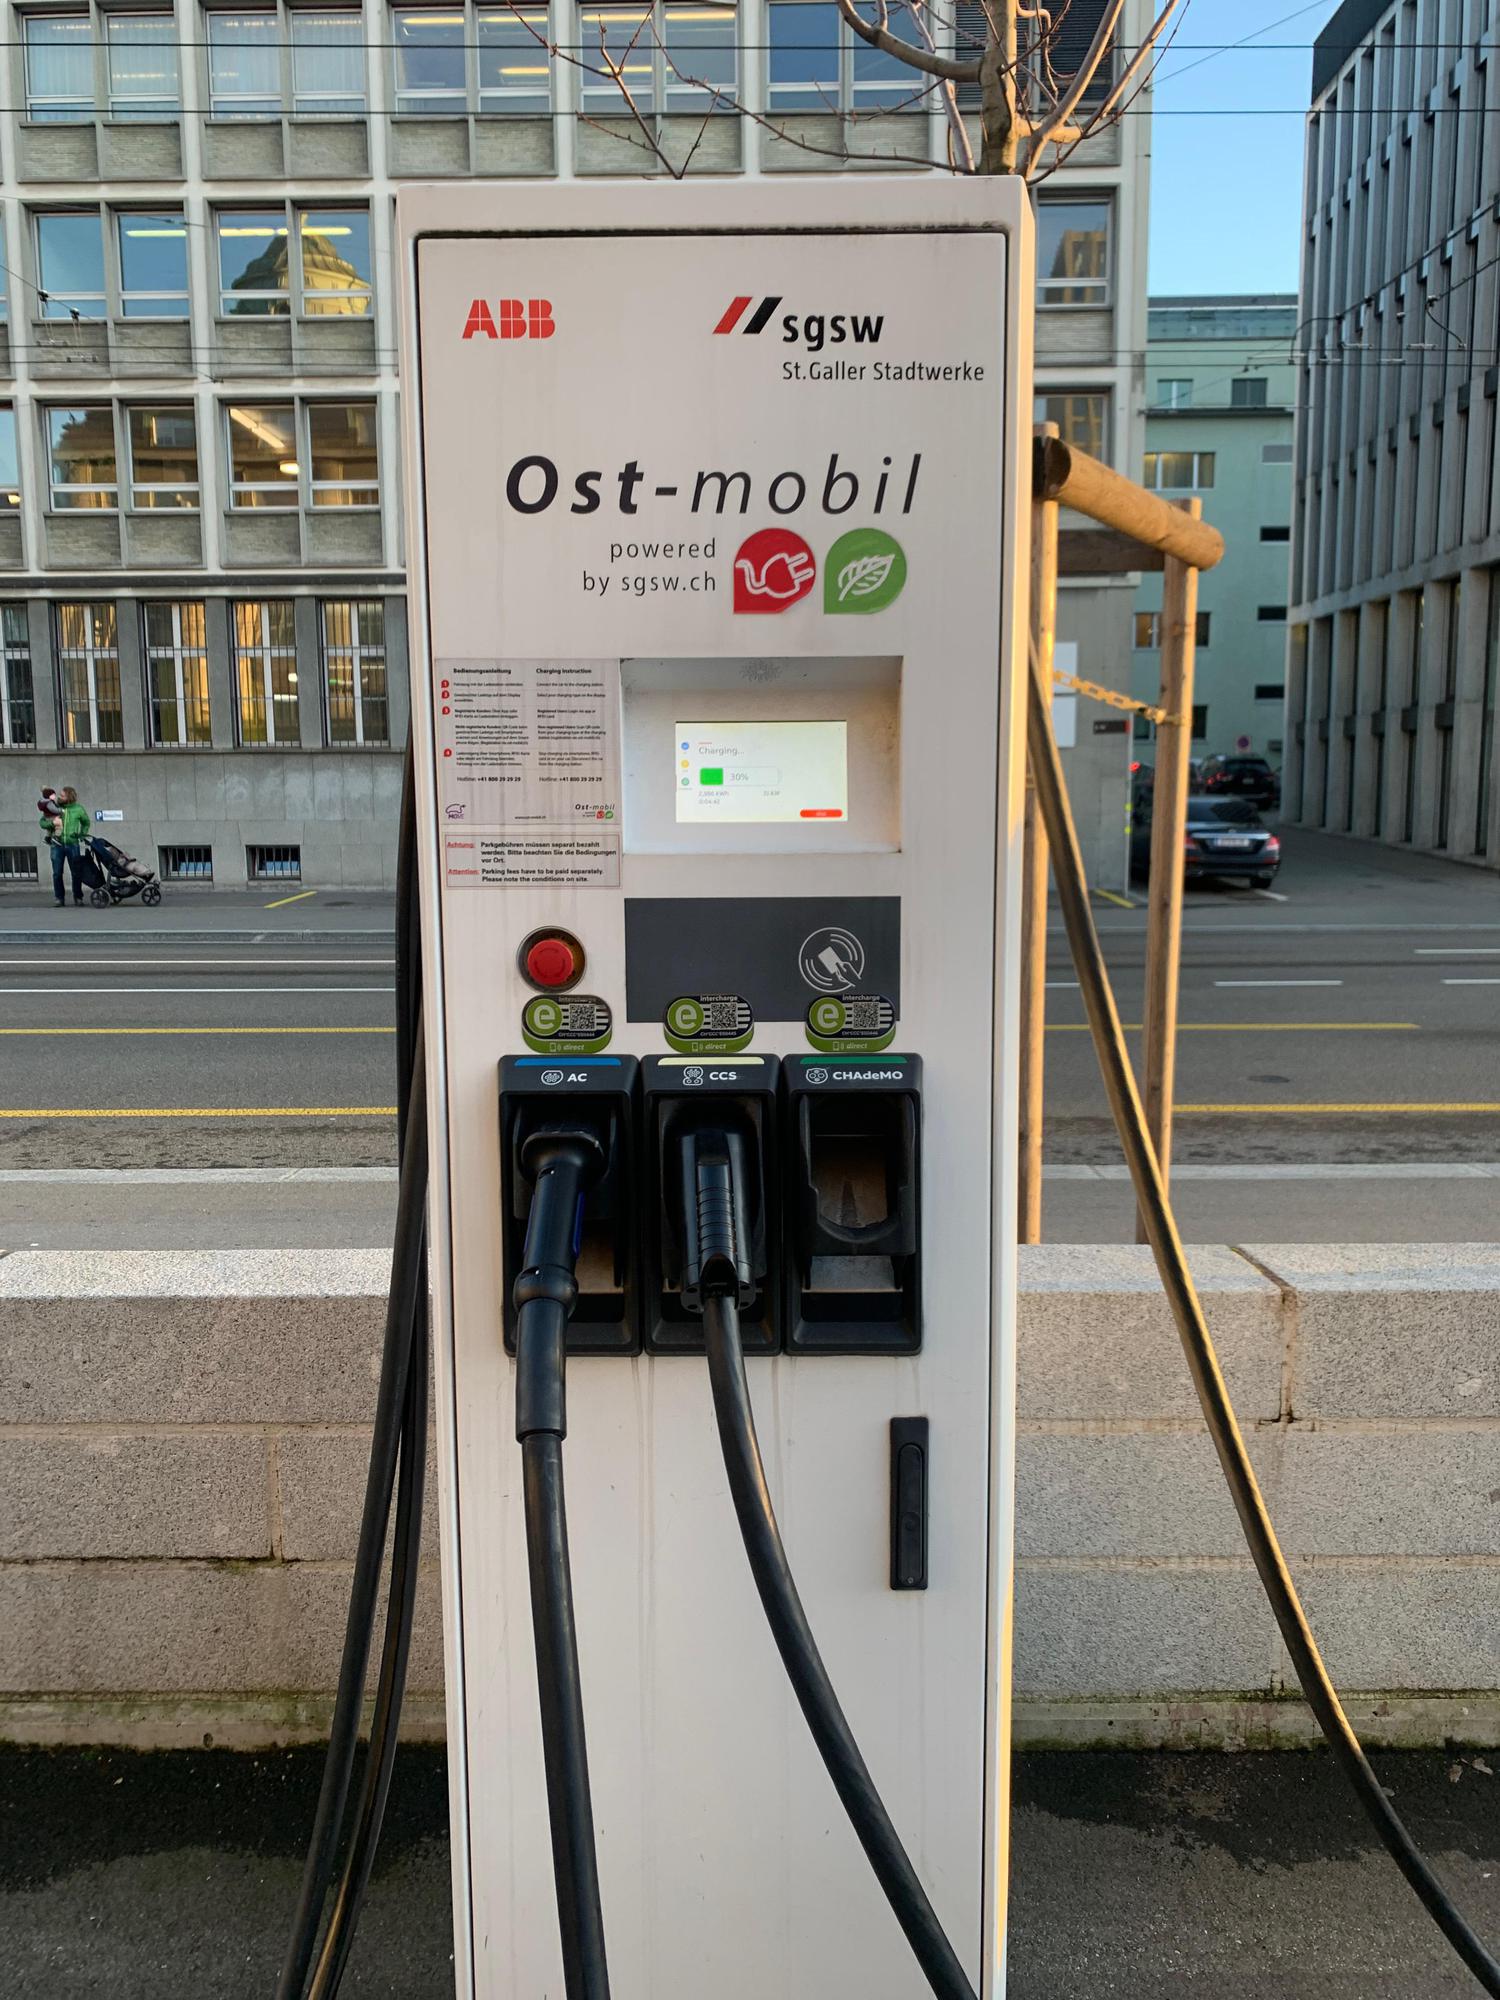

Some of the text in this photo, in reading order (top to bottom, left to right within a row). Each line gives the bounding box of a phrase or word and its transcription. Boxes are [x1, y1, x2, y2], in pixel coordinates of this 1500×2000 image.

[462, 299, 555, 339] ABB
[782, 314, 884, 352] sgsw
[783, 361, 985, 381] St.Galler Stadtwerke
[505, 453, 922, 515] Ost-mobil
[609, 538, 716, 563] powered
[583, 571, 716, 597] by sgsw.ch
[701, 994, 738, 1002] intercharge
[842, 993, 880, 1001] intercharge
[567, 1072, 588, 1083] AC
[709, 1071, 737, 1081] CCS
[832, 1070, 903, 1081] CHAdeMO
